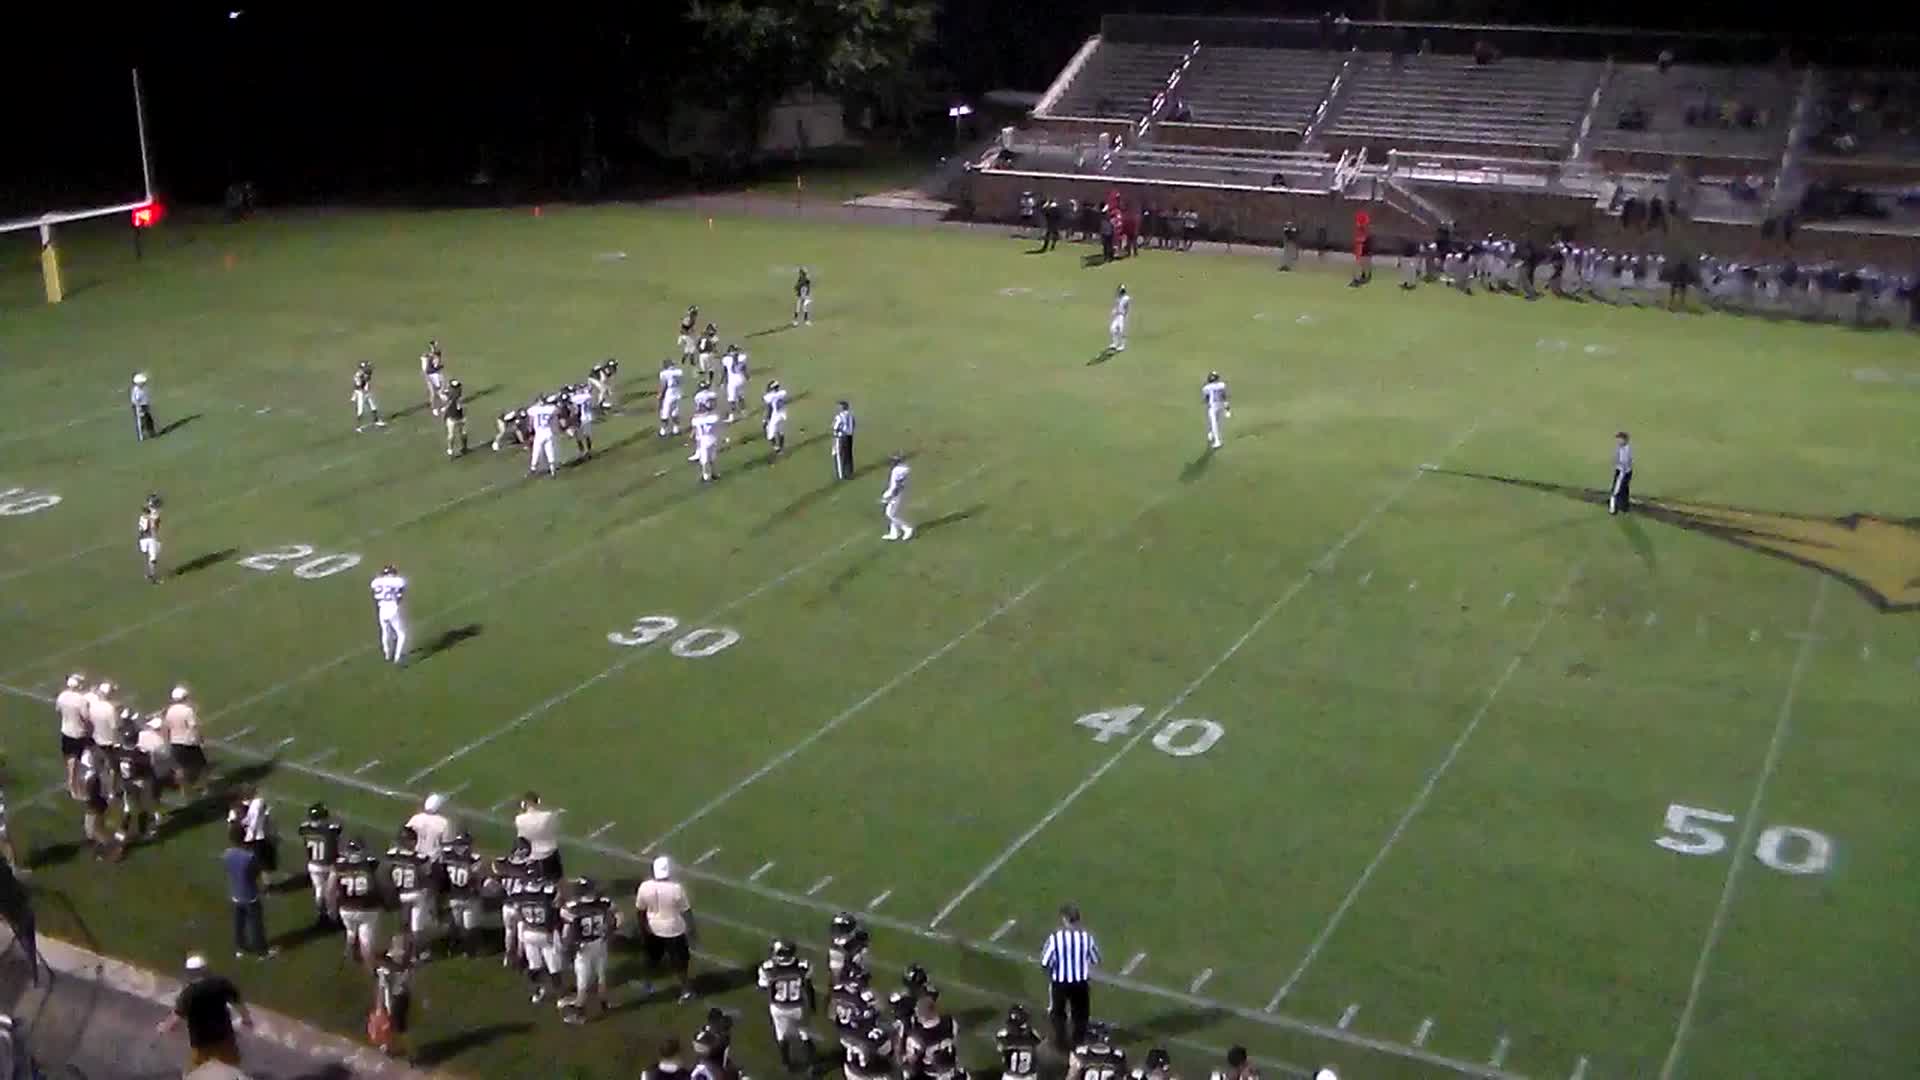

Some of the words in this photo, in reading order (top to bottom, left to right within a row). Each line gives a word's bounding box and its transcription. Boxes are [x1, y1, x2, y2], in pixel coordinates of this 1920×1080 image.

[236, 544, 361, 579] 20
[607, 616, 741, 658] 30
[1073, 704, 1225, 757] 40
[1654, 804, 1830, 874] 50
